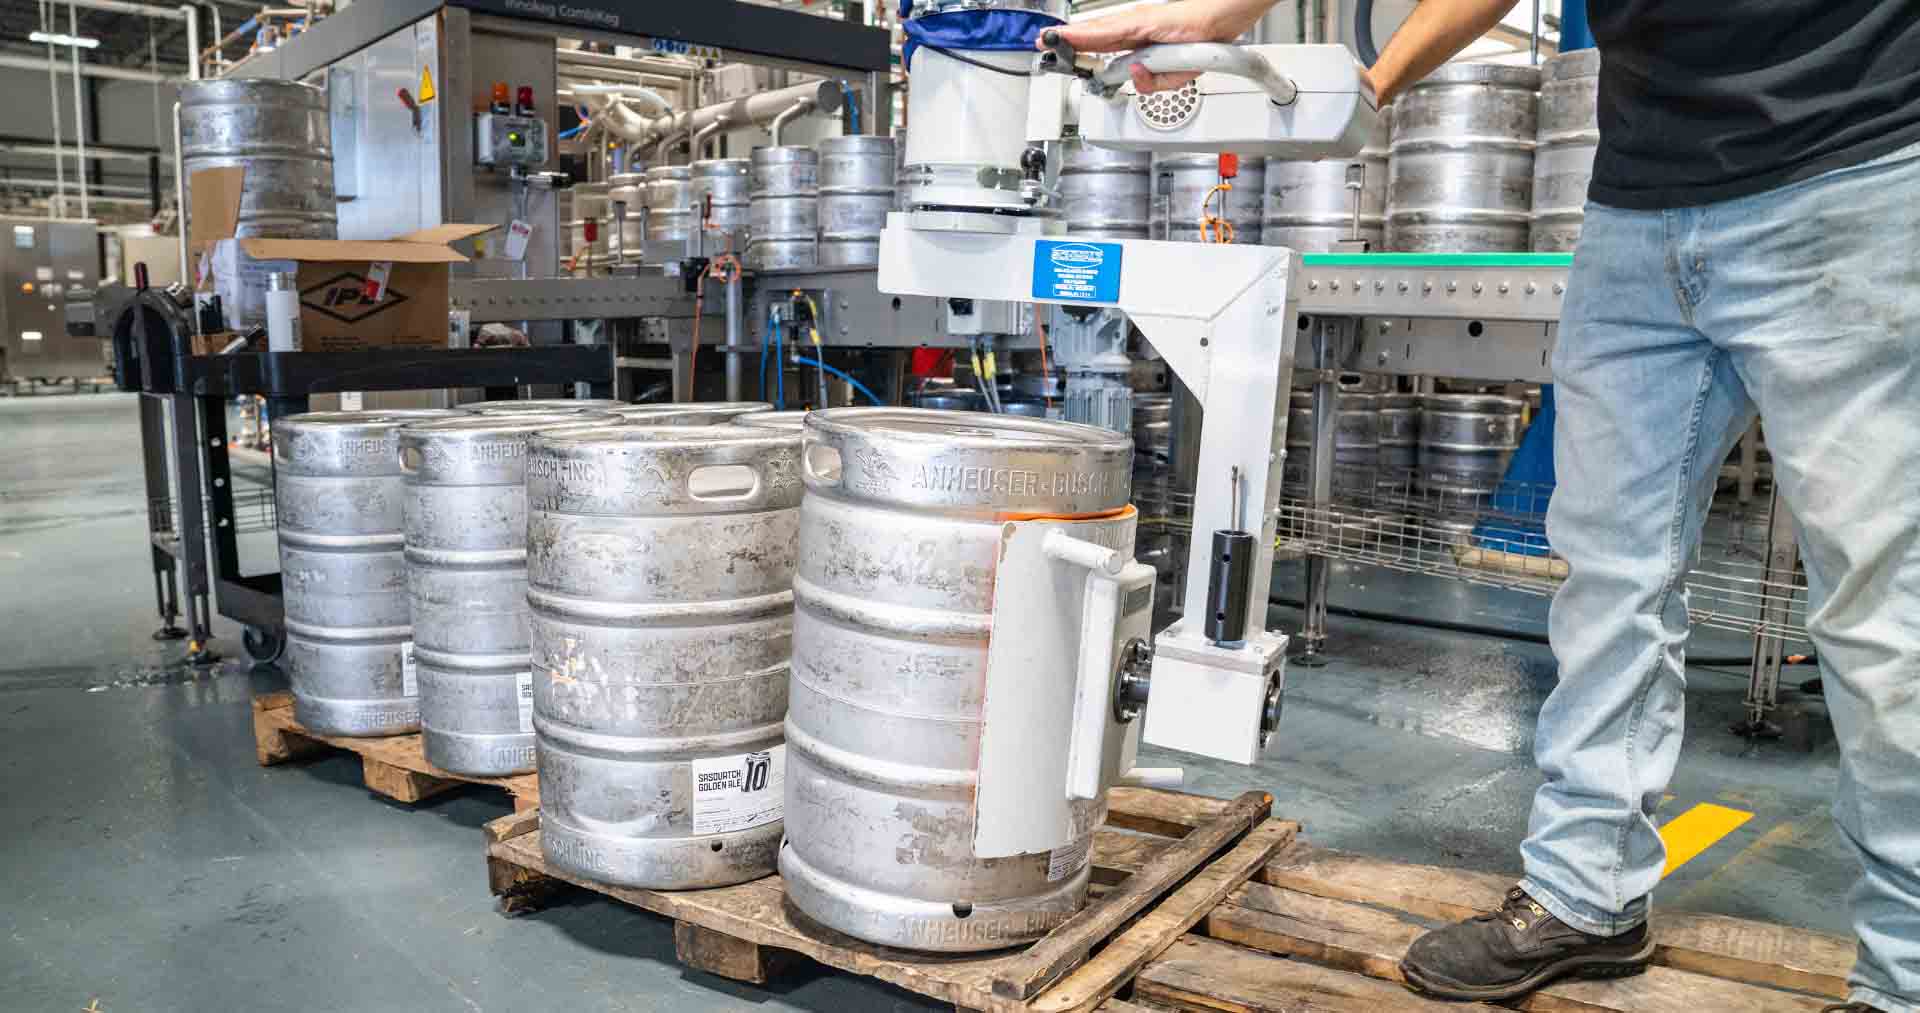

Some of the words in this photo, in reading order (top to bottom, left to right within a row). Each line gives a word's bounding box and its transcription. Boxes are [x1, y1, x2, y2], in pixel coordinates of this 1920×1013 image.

[698, 769, 741, 783] SASQUATCH
[744, 760, 768, 793] 10
[698, 780, 727, 792] GOLDEN
[728, 778, 741, 789] ALE
